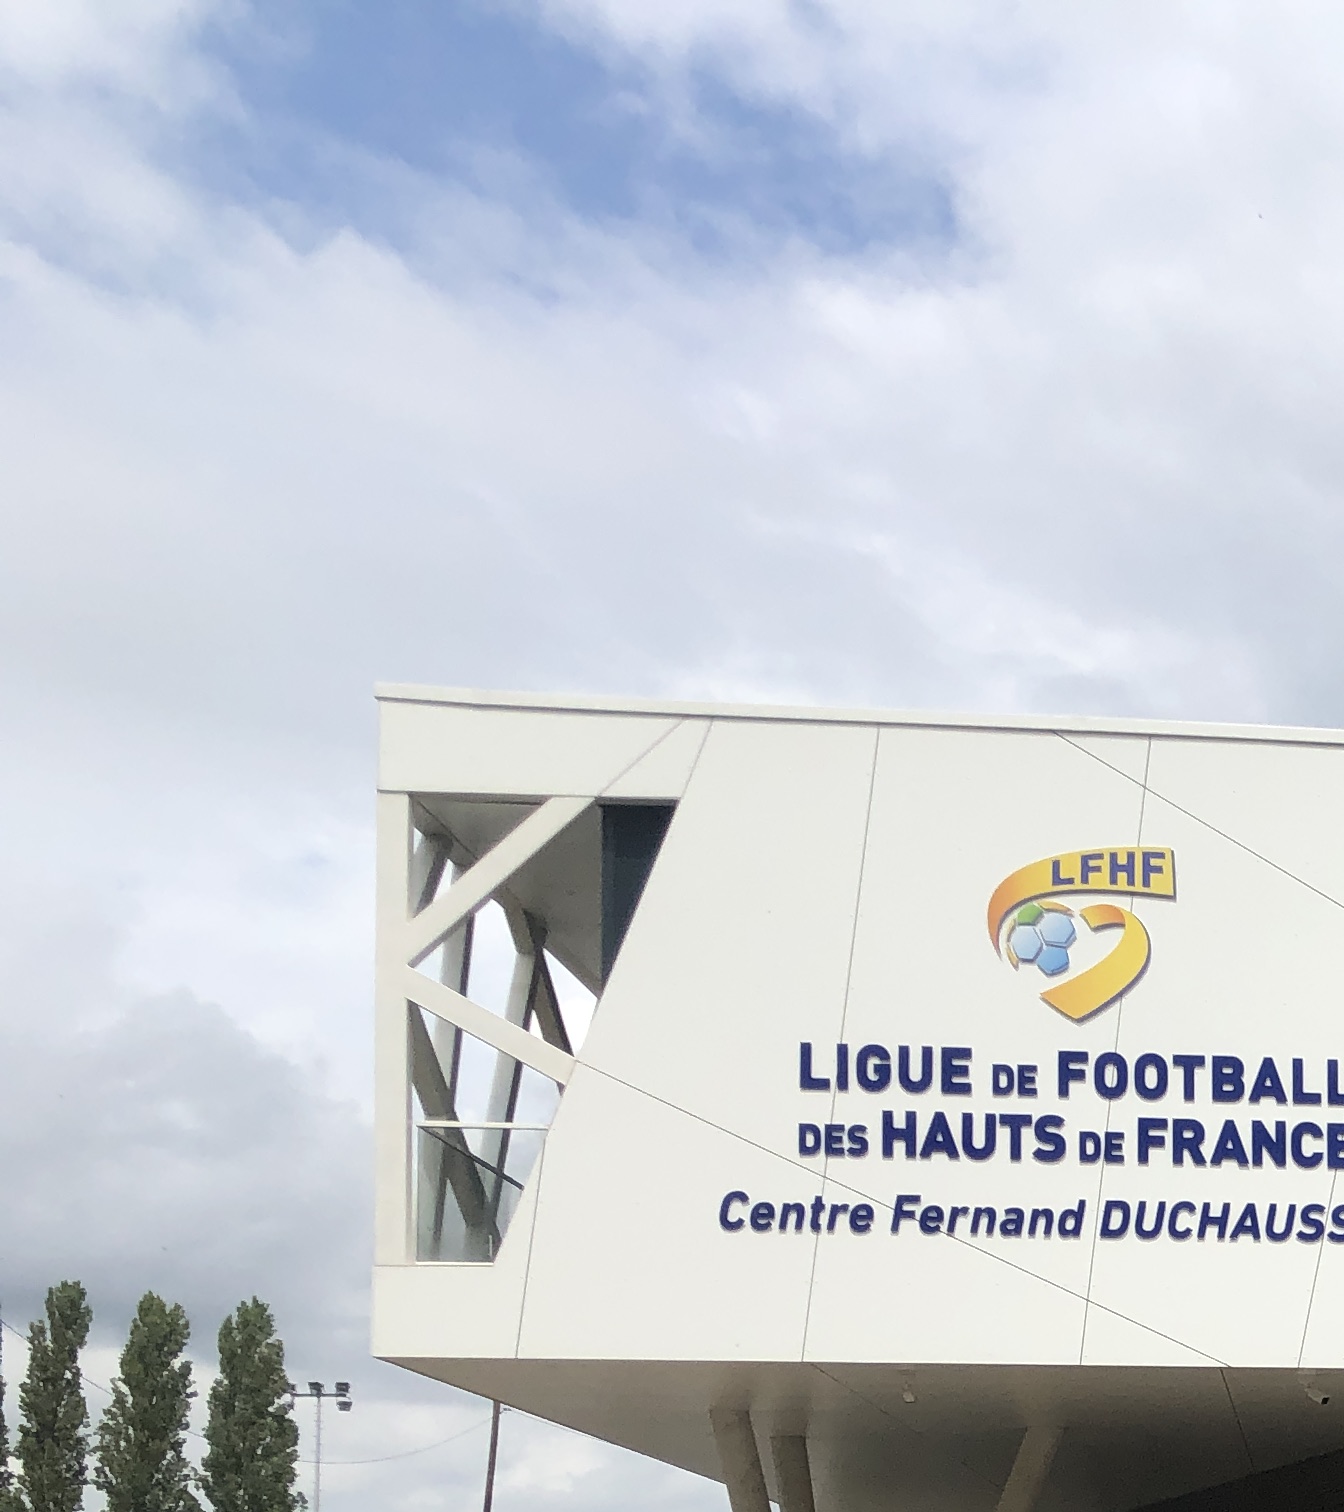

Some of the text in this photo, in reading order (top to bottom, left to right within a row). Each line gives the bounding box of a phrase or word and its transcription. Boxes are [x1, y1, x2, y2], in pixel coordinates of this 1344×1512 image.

[1050, 851, 1166, 888] LFHF
[799, 1042, 974, 1096] LIGUE
[992, 1063, 1039, 1098] DE
[798, 1123, 870, 1159] DES
[882, 1110, 1068, 1164] HAUTS
[1079, 1130, 1126, 1165] DE
[719, 1190, 876, 1234] Centre
[890, 1194, 1084, 1239] Fernand
